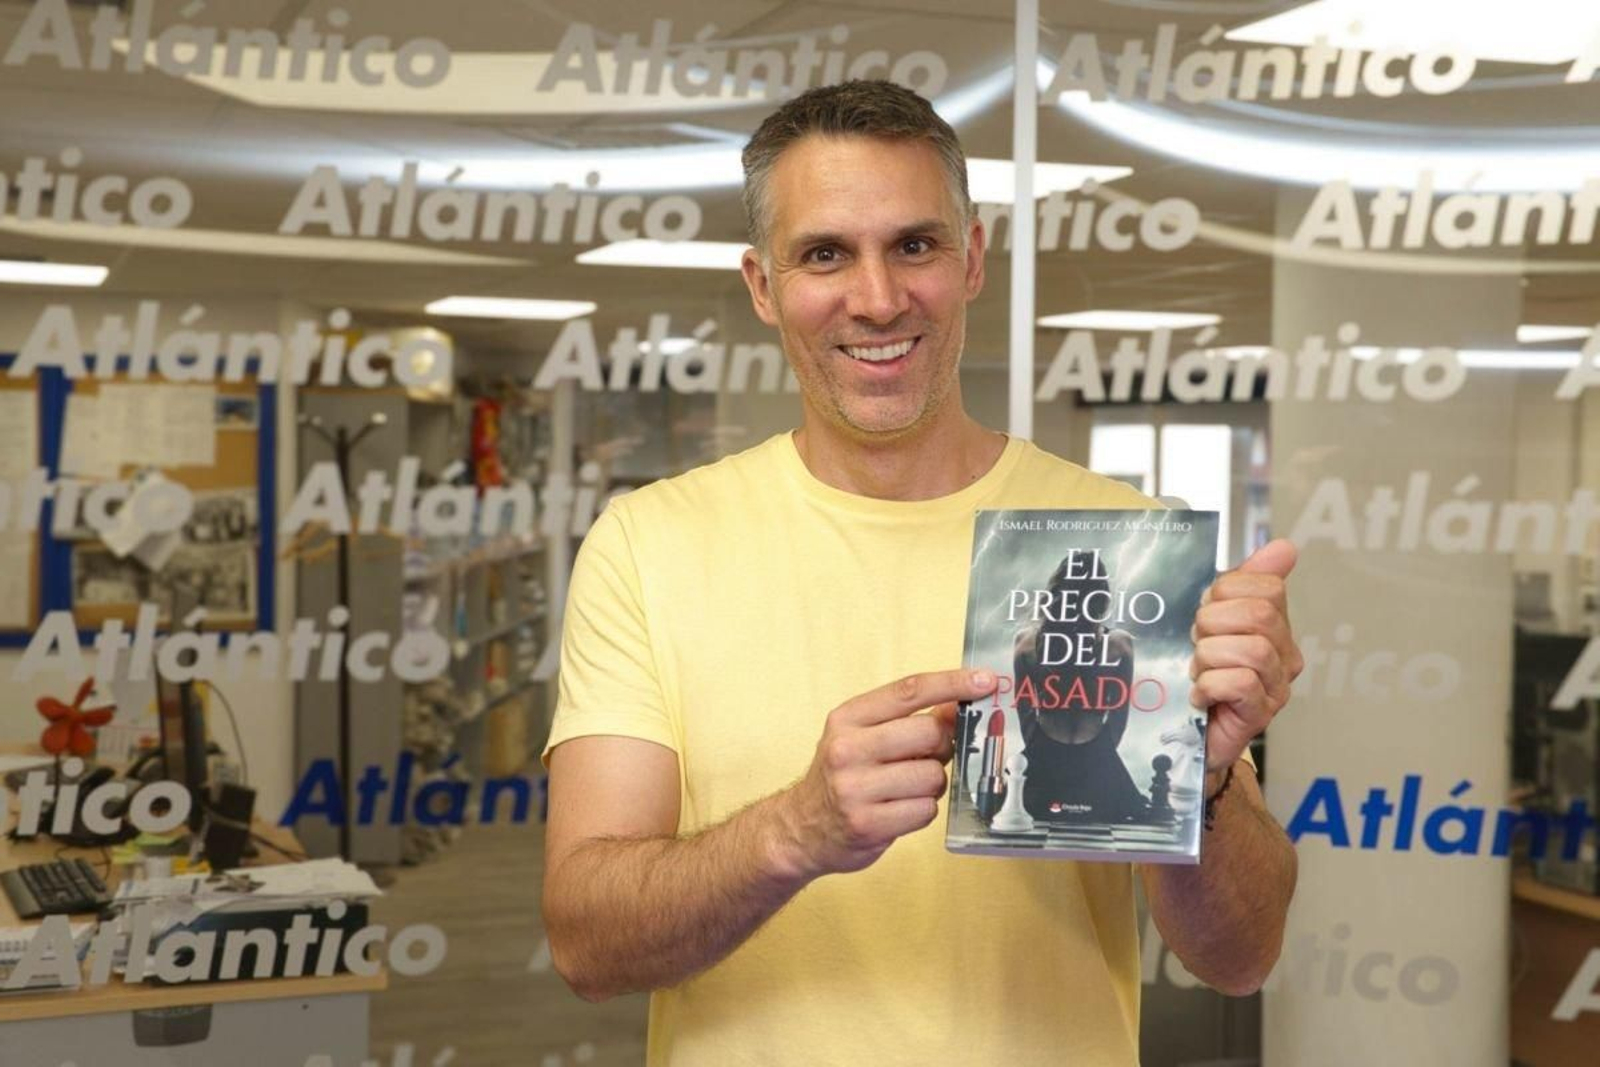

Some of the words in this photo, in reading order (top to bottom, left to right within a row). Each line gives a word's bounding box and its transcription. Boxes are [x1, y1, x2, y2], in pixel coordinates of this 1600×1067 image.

[4, 0, 452, 88] Atlántico
[536, 19, 948, 99] Atlántico
[1044, 20, 1477, 102] Atlántico
[0, 147, 193, 229] tico
[278, 162, 700, 243] Atlántico
[8, 302, 452, 388] Atlántico
[1036, 322, 1467, 402] Atlántico
[0, 466, 193, 533] tico
[999, 519, 1043, 531] ISMAEL
[1064, 548, 1110, 581] EL
[10, 603, 451, 683] Atlántico
[1006, 590, 1166, 624] PRECIO
[1040, 632, 1122, 668] DEL
[991, 674, 1168, 713] PASADO
[0, 757, 192, 835] tico
